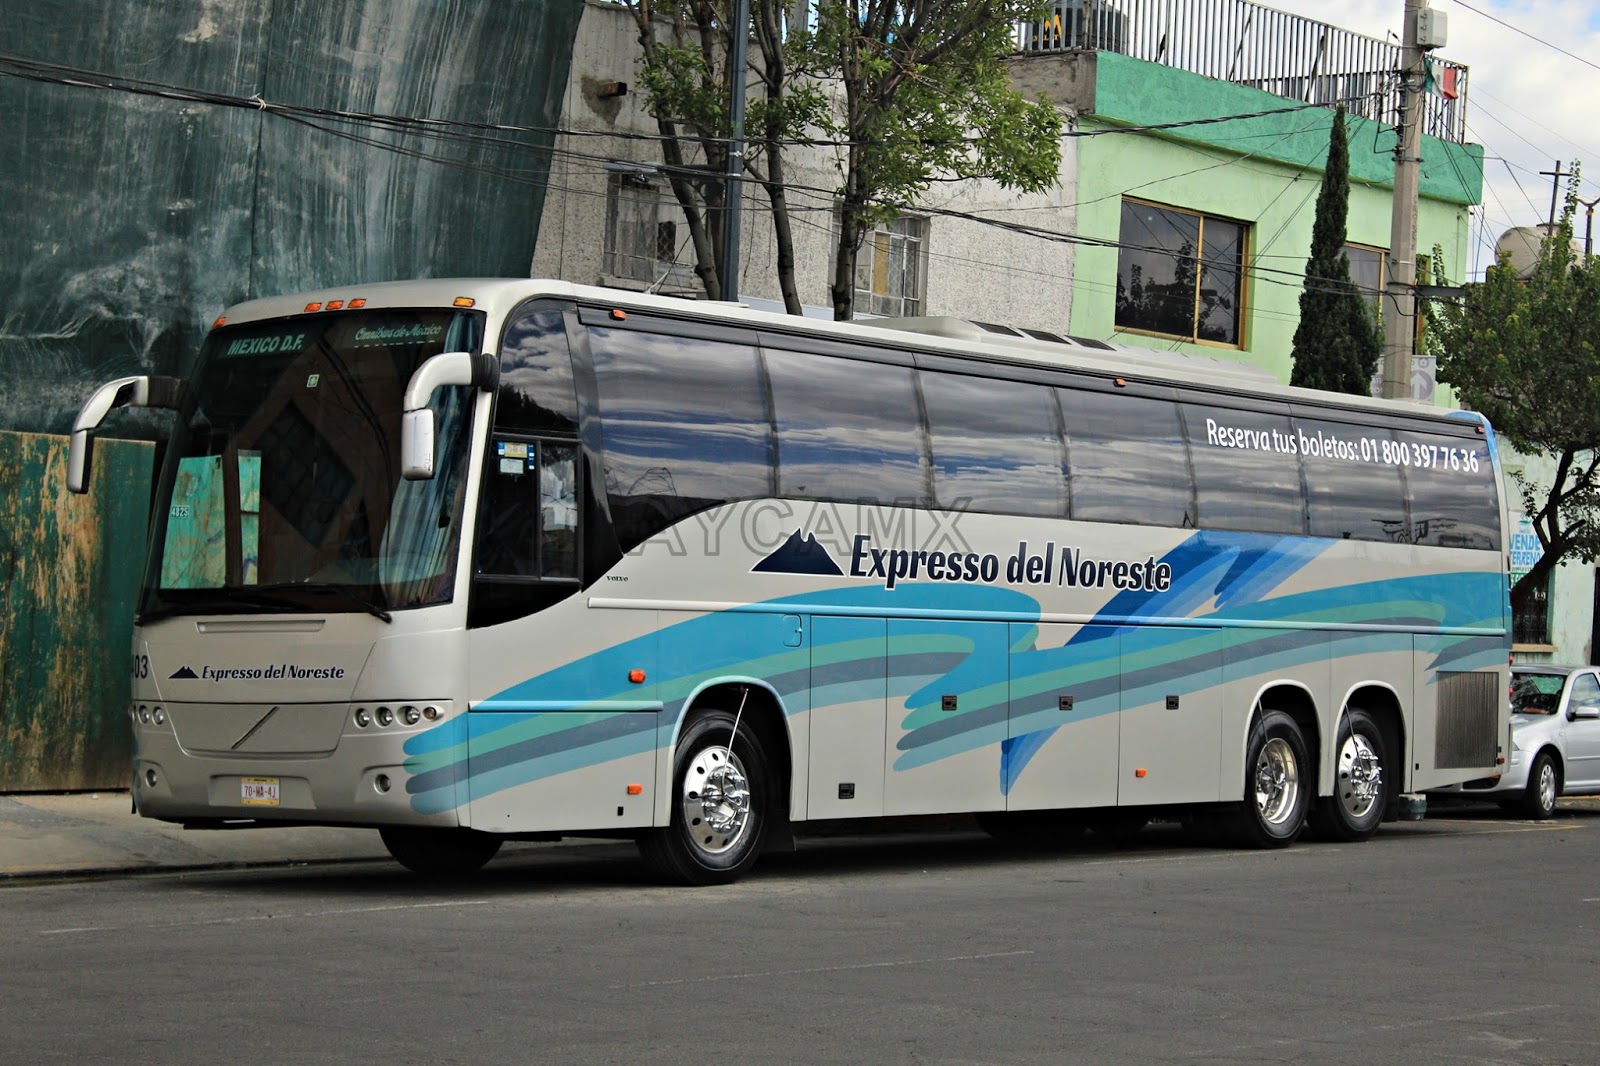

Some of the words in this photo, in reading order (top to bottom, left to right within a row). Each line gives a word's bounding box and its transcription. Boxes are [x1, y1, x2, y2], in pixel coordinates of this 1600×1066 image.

[227, 335, 279, 356] MEXICO
[279, 334, 305, 352] D.F.
[1206, 418, 1271, 452] Reserva
[1272, 428, 1298, 455] tus
[1298, 428, 1360, 461] boletos:
[1360, 437, 1379, 463] 01
[1381, 439, 1411, 466] 800
[1411, 443, 1438, 469] 397
[1440, 446, 1460, 471] 76
[1460, 448, 1479, 473] 36
[171, 506, 189, 518] 4825
[850, 533, 999, 589] Expresso
[1006, 540, 1054, 584] del
[1058, 546, 1172, 592] Noreste
[201, 665, 262, 682] Expresso
[263, 664, 287, 680] del
[287, 664, 345, 680] Noreste
